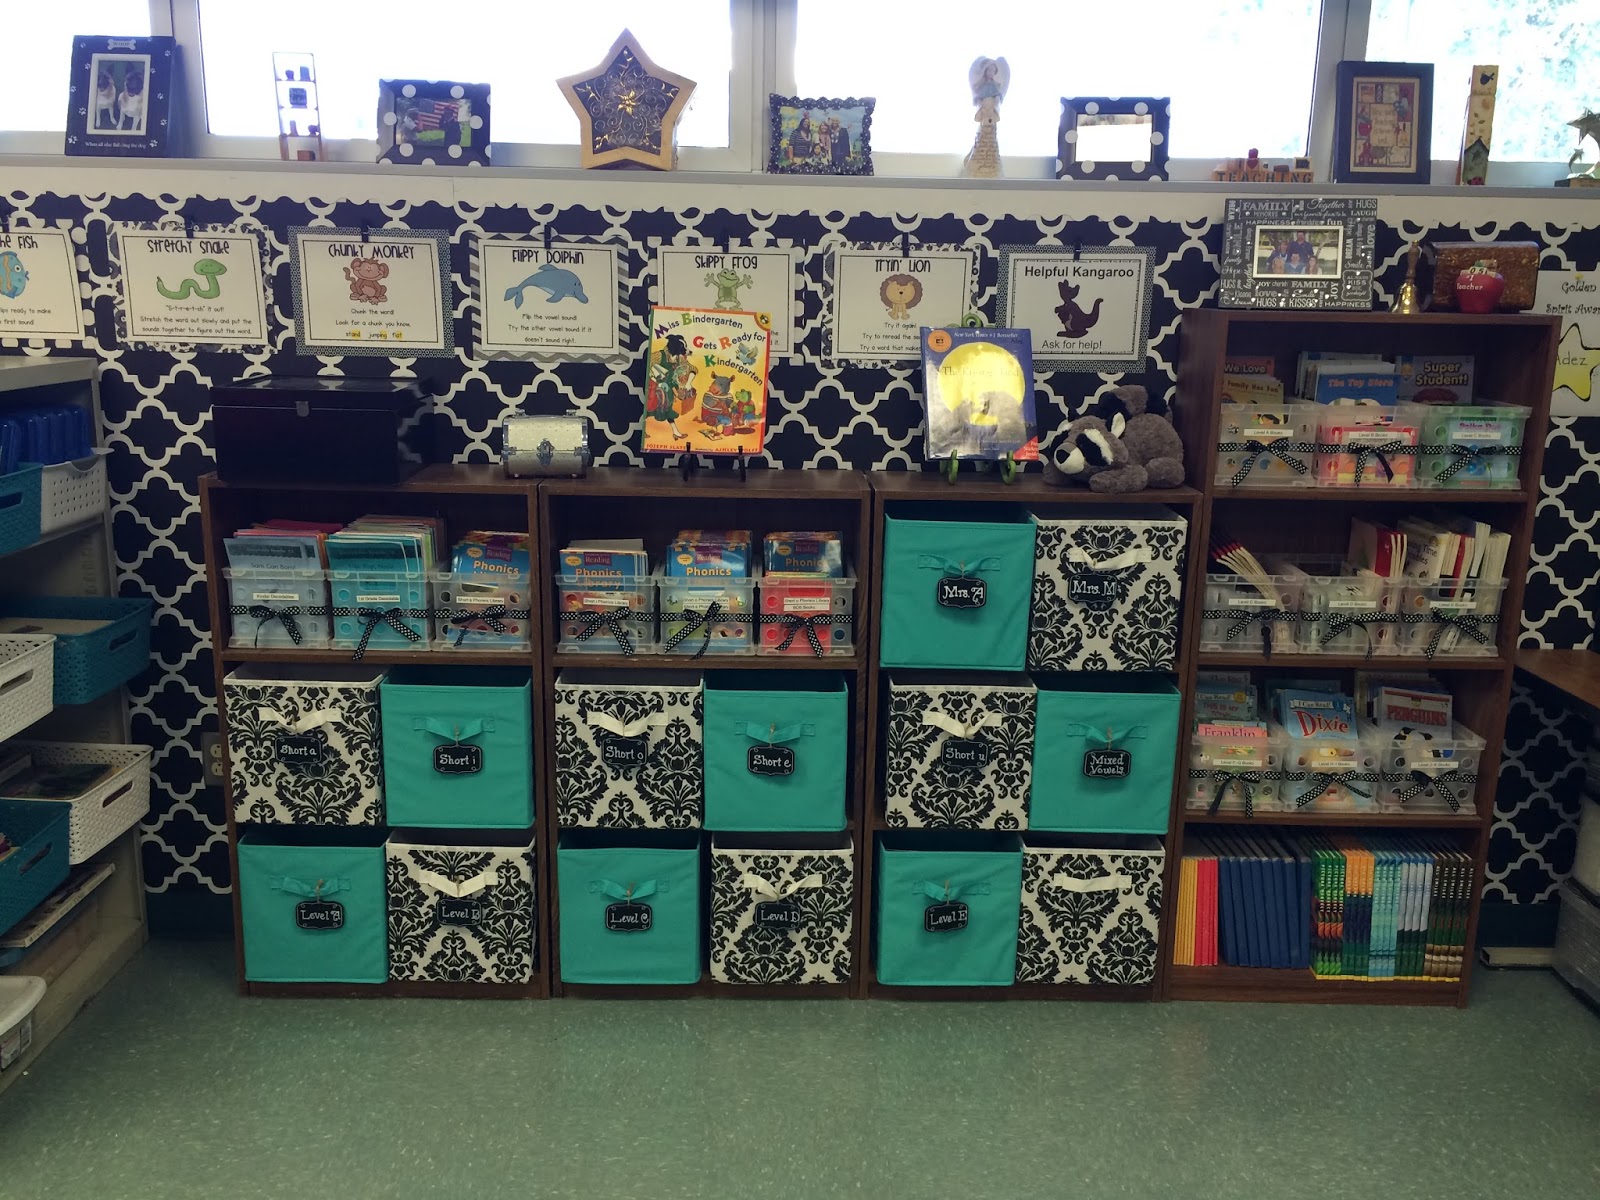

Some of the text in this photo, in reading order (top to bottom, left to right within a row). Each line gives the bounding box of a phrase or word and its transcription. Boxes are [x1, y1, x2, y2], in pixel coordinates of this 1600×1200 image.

[1216, 172, 1312, 182] TEACHING
[1242, 202, 1290, 210] FAMILY
[1307, 198, 1345, 212] Together
[1356, 200, 1376, 208] HUGS
[1364, 224, 1376, 249] love
[1024, 266, 1134, 280] Helpful Kangaroo
[1221, 280, 1236, 288] HUGS
[1562, 280, 1597, 294] Golden
[1330, 282, 1338, 299] JOY
[1256, 298, 1276, 307] HUGS
[1546, 304, 1600, 314] Spirit Awar
[508, 324, 518, 332] Try
[654, 312, 742, 340] Miss Bindergarten
[692, 336, 717, 350] Gets
[719, 333, 752, 350] Ready
[753, 332, 766, 342] for
[1042, 340, 1102, 351] Ask for help!
[704, 354, 763, 386] Kindergarten
[1224, 363, 1266, 373] We Love
[1424, 362, 1462, 374] Super
[1228, 380, 1249, 390] Family
[1328, 379, 1344, 388] The
[1348, 379, 1364, 388] Toy
[1416, 374, 1468, 386] Student!
[586, 556, 610, 565] Reading
[474, 560, 519, 574] Phonics
[576, 568, 622, 578] Phonics
[686, 566, 732, 576] Phonics
[942, 585, 970, 599] Mrs.
[1072, 580, 1116, 596] Mrs. M
[1293, 710, 1348, 736] Dixie
[1204, 728, 1256, 737] Franklin
[280, 744, 308, 756] Short
[606, 746, 644, 760] Short o
[946, 748, 986, 761] Short u
[440, 753, 476, 766] Short i
[753, 754, 792, 768] Short e
[1090, 754, 1124, 766] Mixed
[1090, 766, 1124, 775] Vowels
[300, 910, 340, 922] Level A
[442, 906, 480, 920] Level B
[610, 912, 638, 924] Level
[760, 910, 800, 922] Level D
[930, 910, 968, 925] Level E
